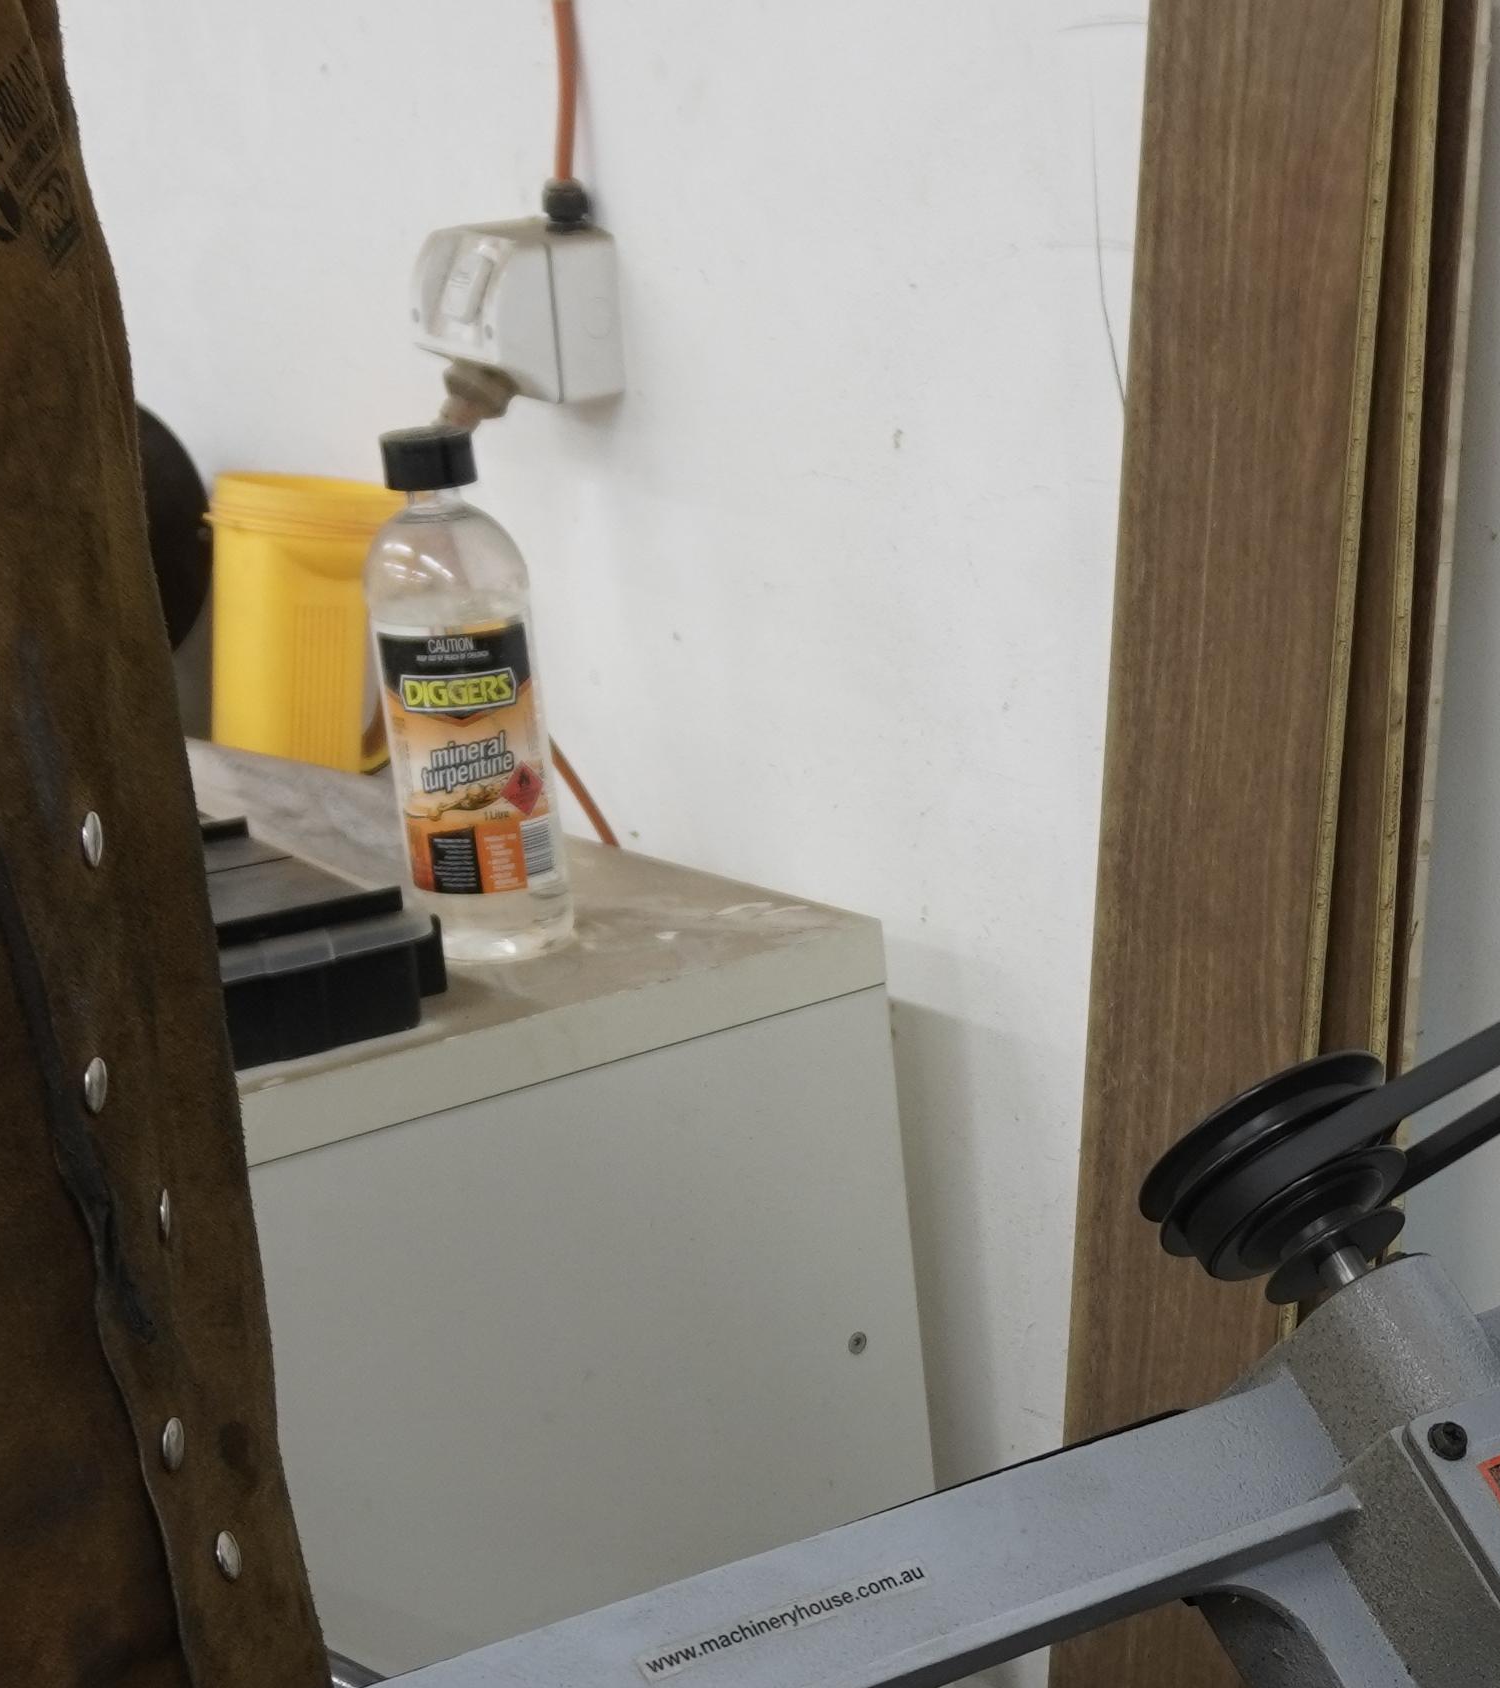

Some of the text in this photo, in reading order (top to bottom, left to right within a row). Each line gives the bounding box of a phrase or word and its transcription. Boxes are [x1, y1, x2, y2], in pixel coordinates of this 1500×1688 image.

[427, 637, 474, 654] CAUTION
[403, 673, 512, 707] DIGGERS
[431, 730, 506, 768] mineral
[421, 751, 514, 793] turpentine
[646, 1565, 925, 1674] www.machineryhouse.com.au
